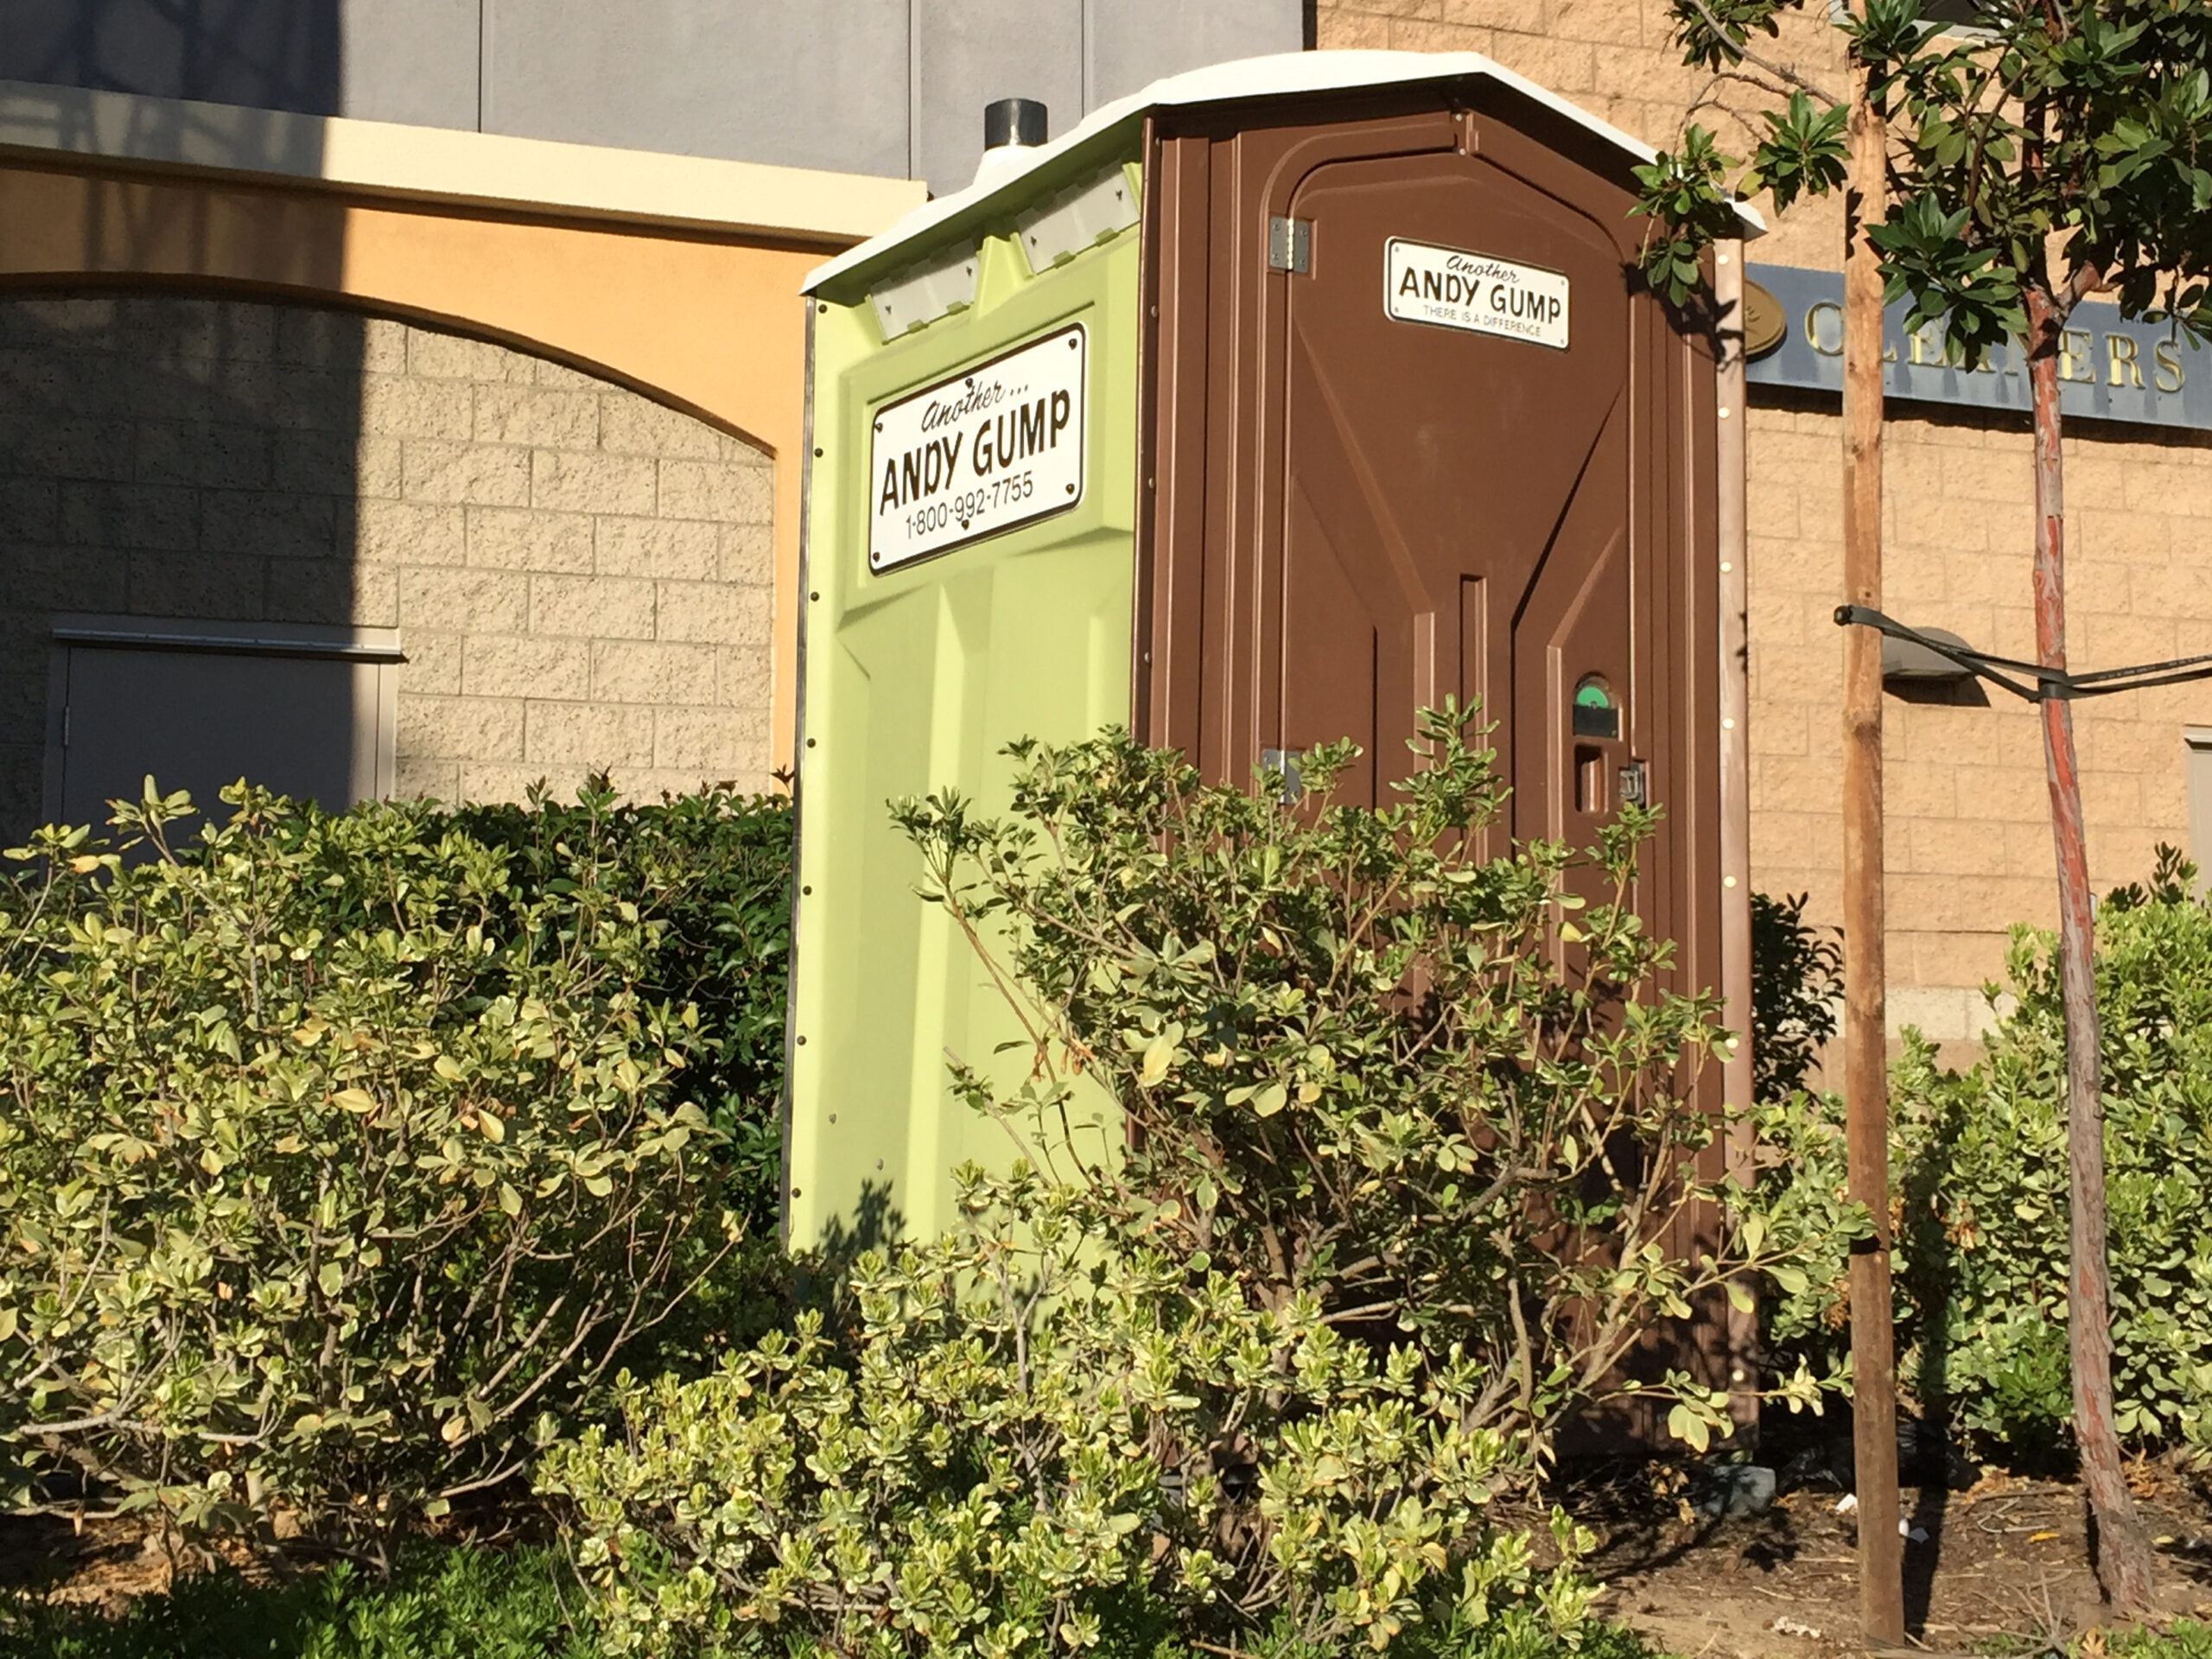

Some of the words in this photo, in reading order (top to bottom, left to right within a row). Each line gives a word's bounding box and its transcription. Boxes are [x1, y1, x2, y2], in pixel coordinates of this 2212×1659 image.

[1398, 266, 1480, 307] ANDY
[1491, 283, 1561, 324] GUMP
[1423, 304, 1457, 320] THERE
[1461, 312, 1471, 323] IS
[1473, 314, 1480, 324] A
[880, 430, 963, 516] ANDY
[973, 389, 1070, 477] GUMP
[906, 470, 1033, 539] 1-800-992-7755
